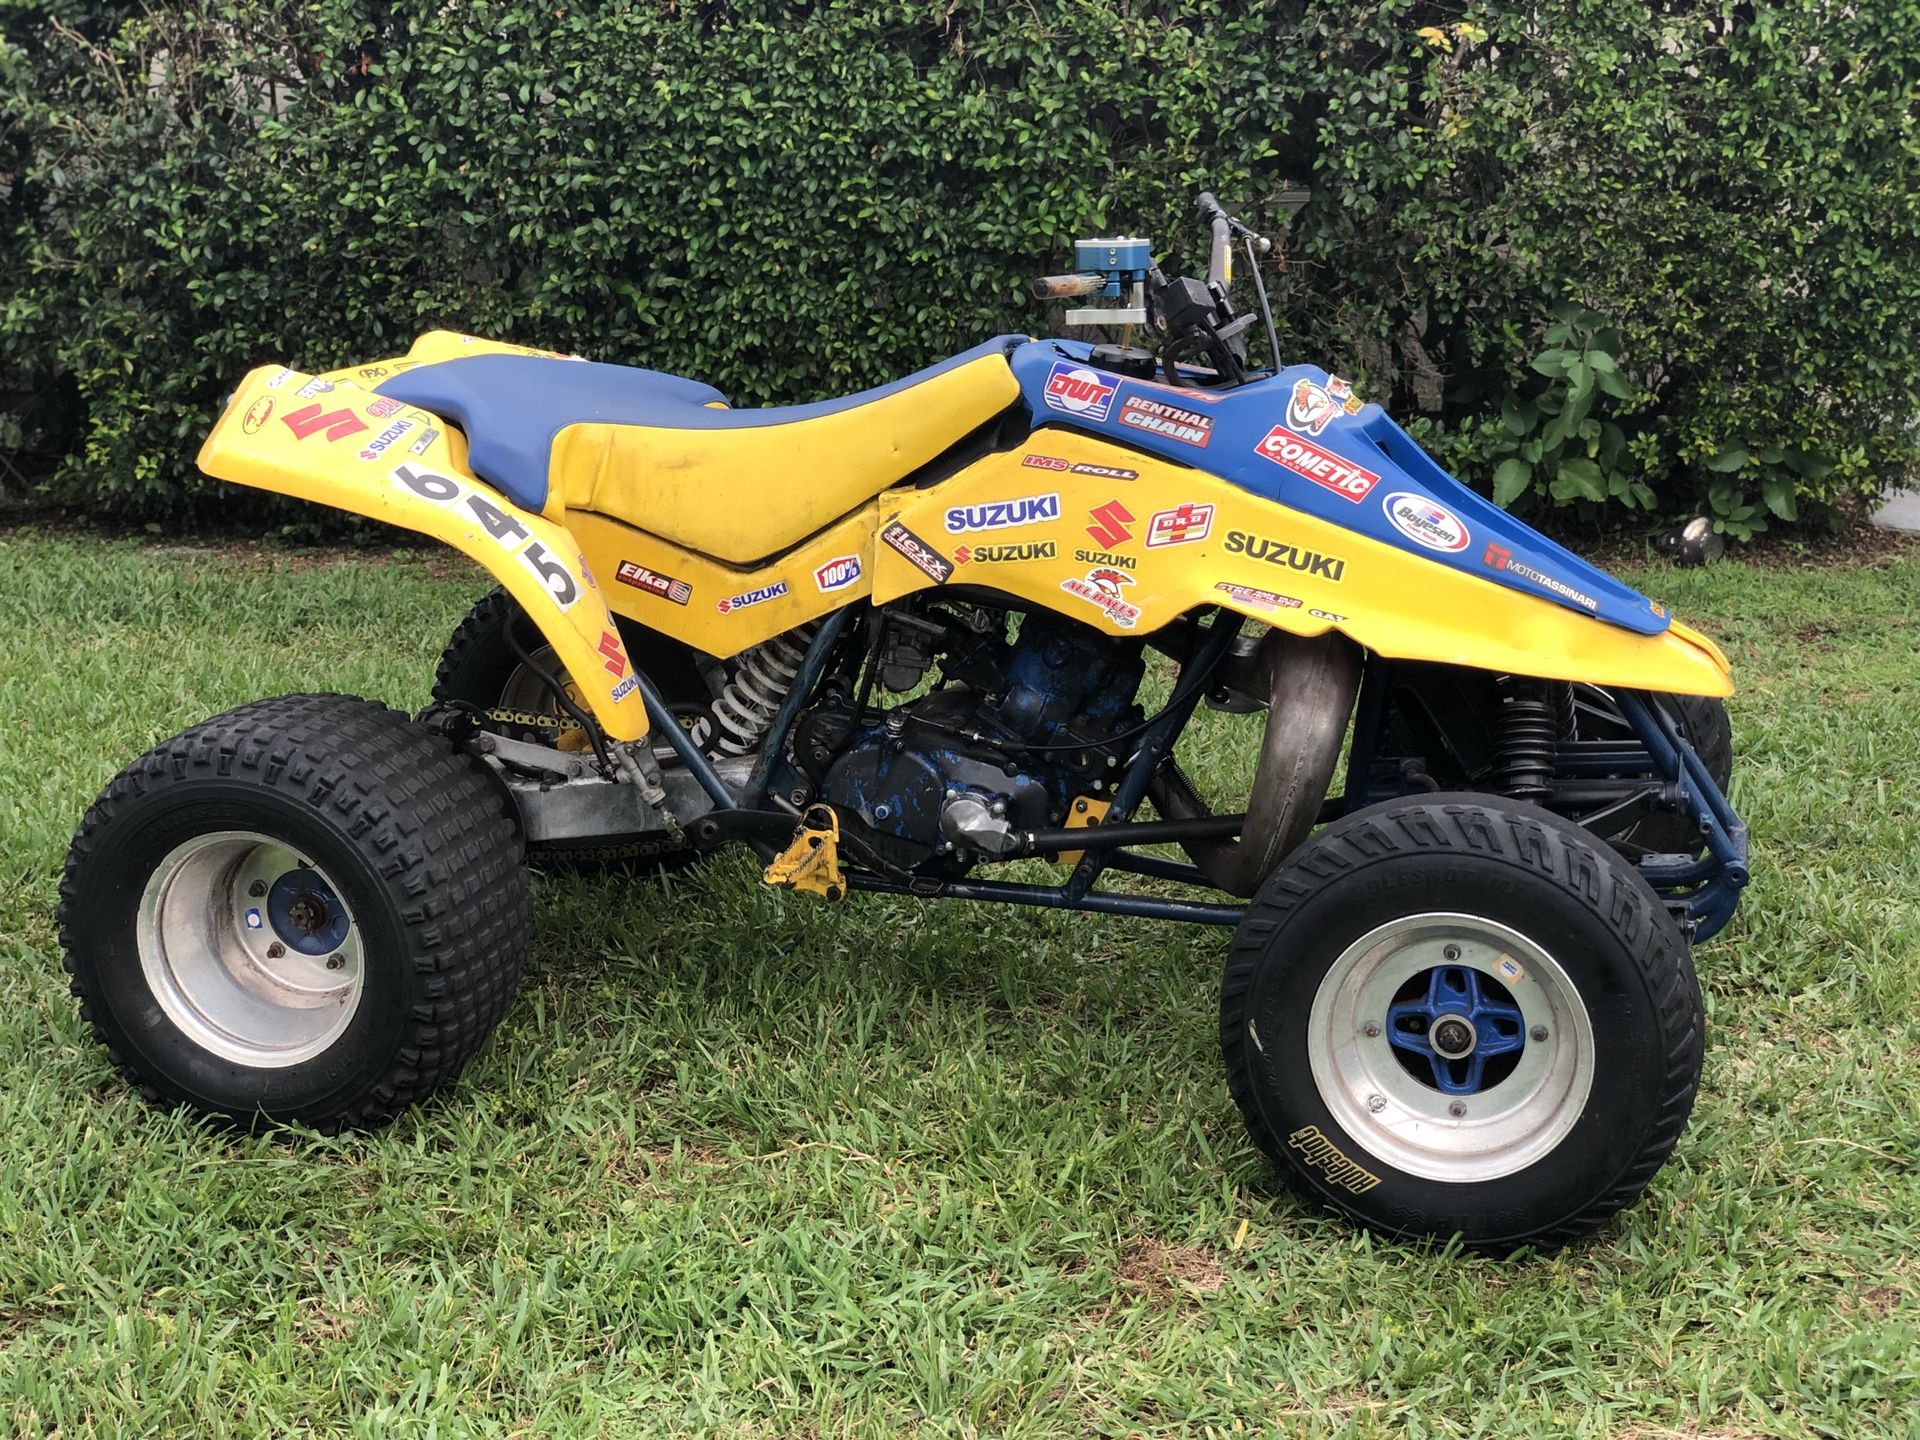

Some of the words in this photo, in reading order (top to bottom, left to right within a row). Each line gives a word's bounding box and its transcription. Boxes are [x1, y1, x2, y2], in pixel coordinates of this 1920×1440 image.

[1047, 373, 1113, 404] DWT
[1124, 411, 1204, 443] CHAIN
[1125, 397, 1211, 430] RENTHAL
[369, 420, 413, 451] SUZUKI
[947, 496, 1058, 531] SUZUKI
[1397, 506, 1456, 542] Boyesen
[395, 466, 576, 605] 645
[974, 541, 1056, 563] SUZUKI
[1075, 550, 1137, 570] SUZUKI
[1224, 531, 1345, 582] SUZUKI
[619, 562, 670, 590] Elka
[820, 557, 859, 588] 100%
[1507, 559, 1597, 610] MOTOTASSINARI
[731, 582, 788, 609] SUZUKI
[1062, 580, 1092, 598] ALL
[1092, 591, 1139, 619] BALLS
